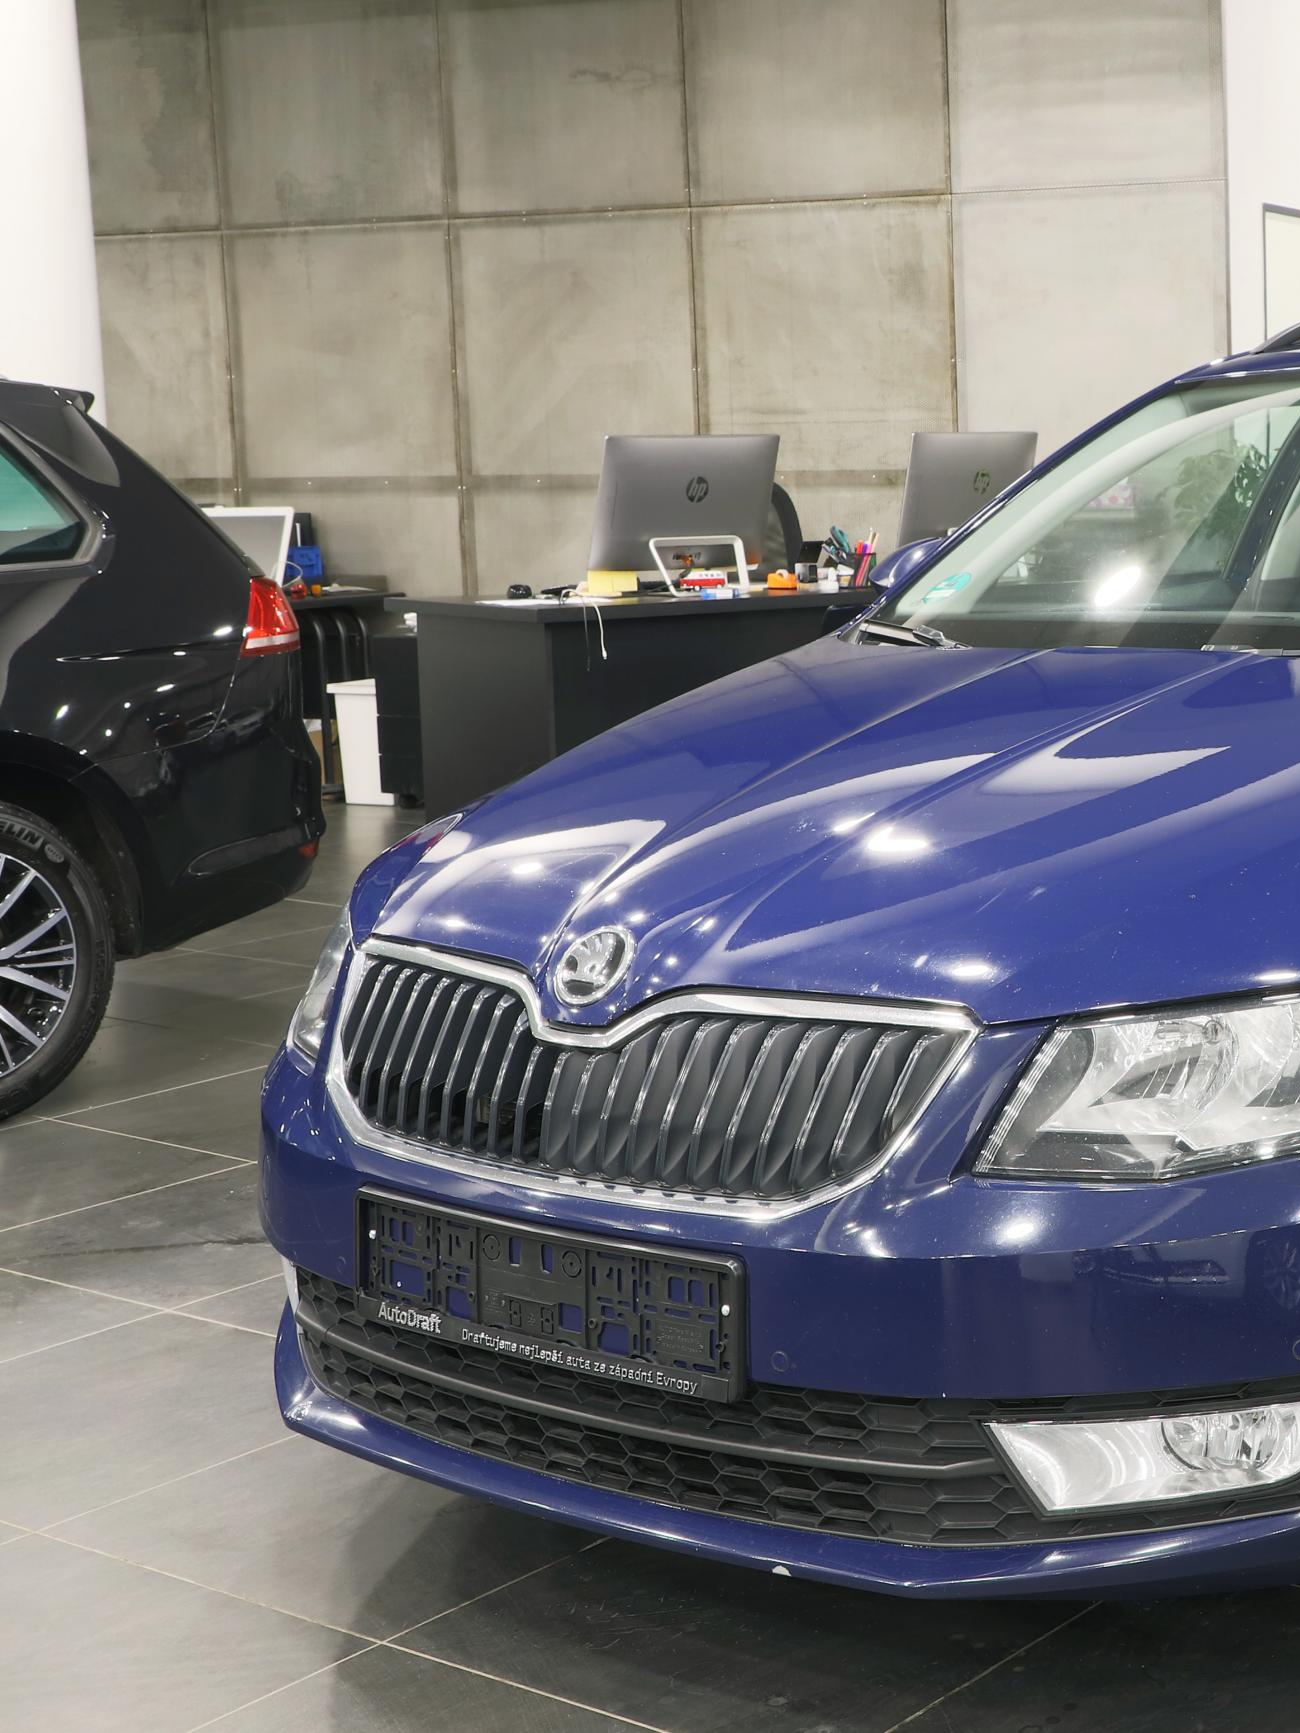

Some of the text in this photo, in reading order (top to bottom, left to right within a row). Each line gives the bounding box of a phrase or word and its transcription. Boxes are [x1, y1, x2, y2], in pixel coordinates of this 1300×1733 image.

[686, 476, 709, 503] hp
[378, 1302, 441, 1334] AutoDraft
[462, 1328, 517, 1353] Draftujeme
[566, 1354, 591, 1370] auta
[594, 1361, 606, 1373] ze
[656, 1371, 698, 1395] Evropy
